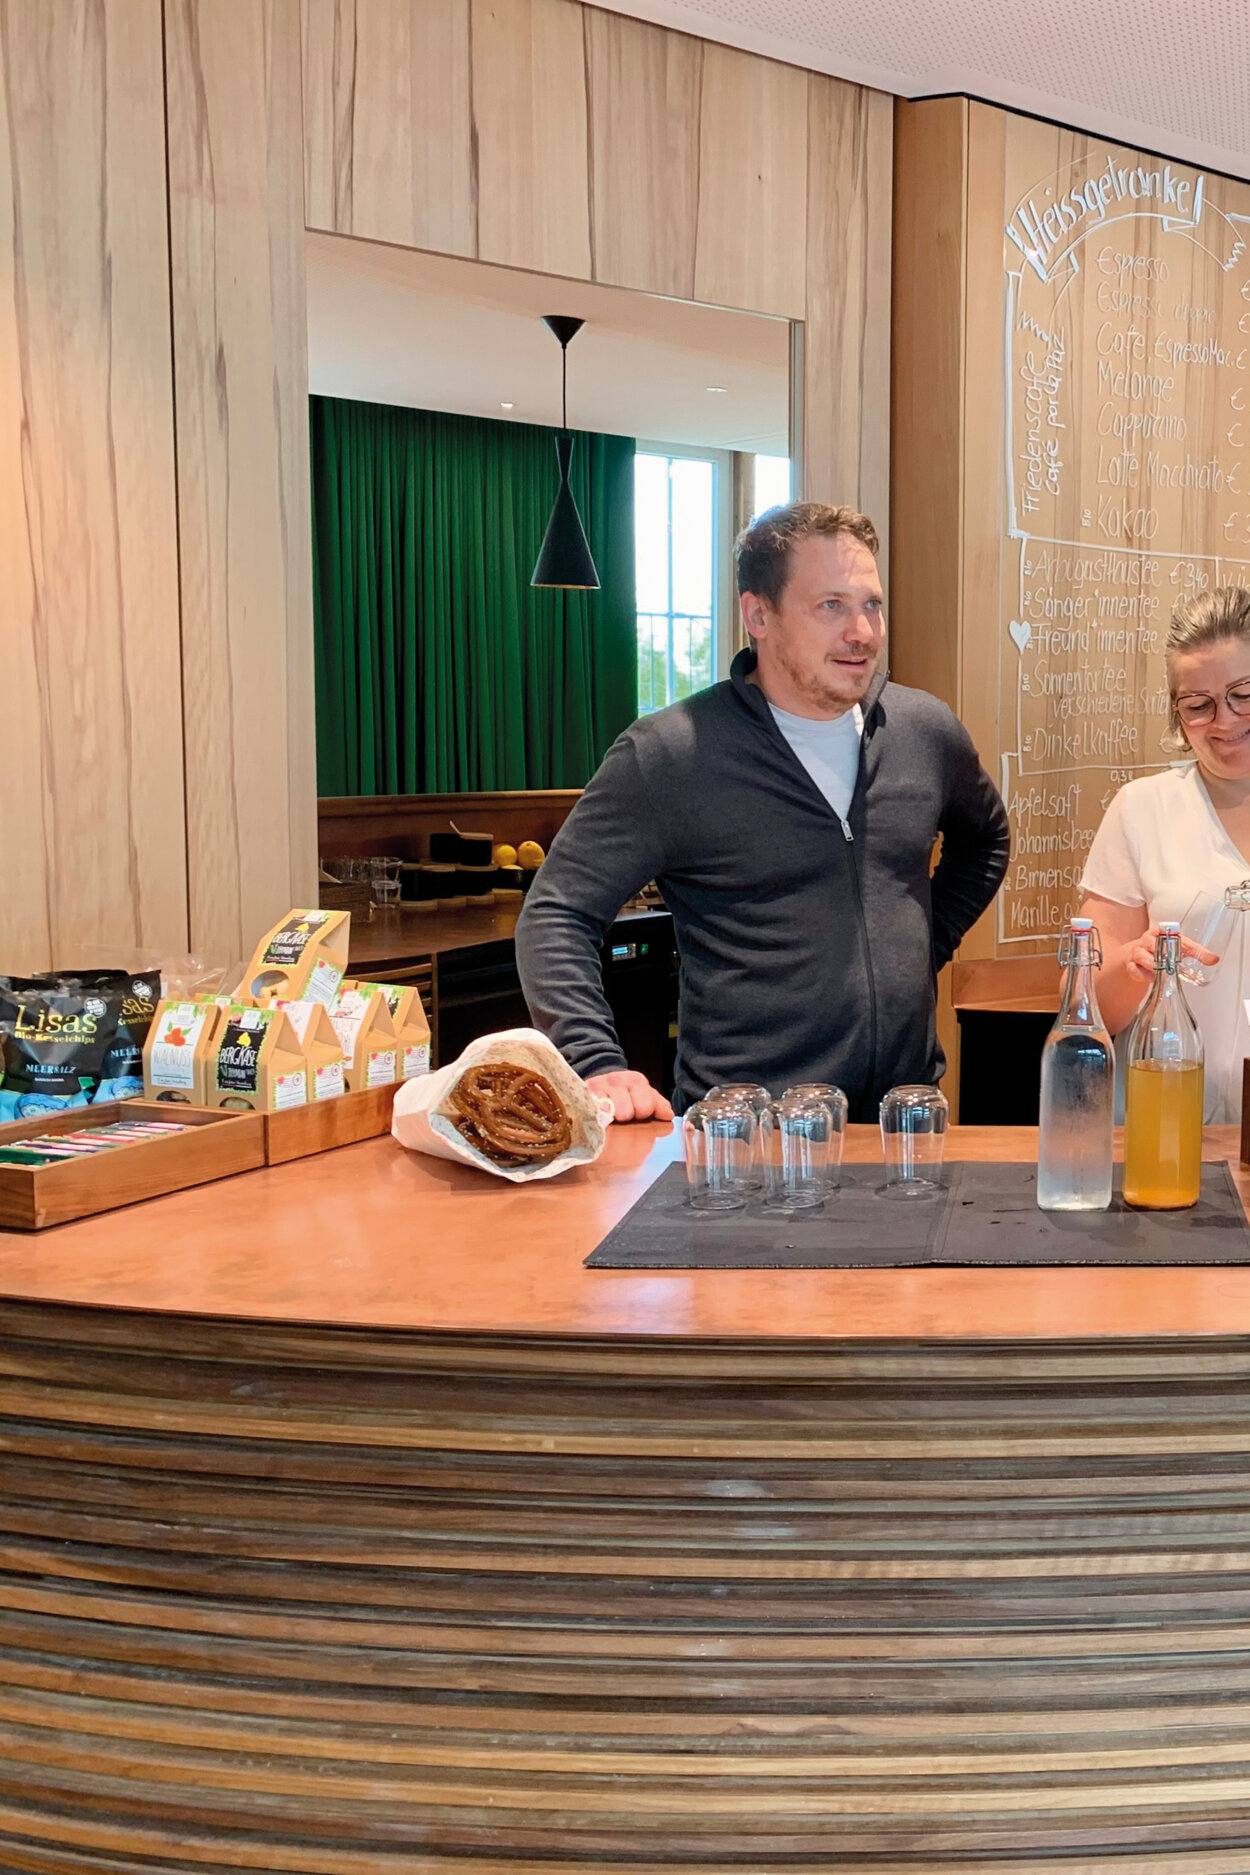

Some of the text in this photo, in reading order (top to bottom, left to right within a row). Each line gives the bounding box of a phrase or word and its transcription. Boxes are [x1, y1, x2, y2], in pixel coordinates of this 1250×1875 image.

[1096, 246, 1169, 289] Espresso
[1097, 359, 1175, 415] Melange
[1097, 444, 1139, 488] Latte
[1147, 451, 1225, 493] Macchiato
[1097, 494, 1159, 540] Kakao
[1033, 718, 1138, 762] Dinkelkaffee
[1007, 783, 1082, 828] Apfelsaft
[1011, 895, 1063, 930] Marille
[14, 1004, 98, 1034] Lisas
[25, 1063, 77, 1075] MEERSALZ
